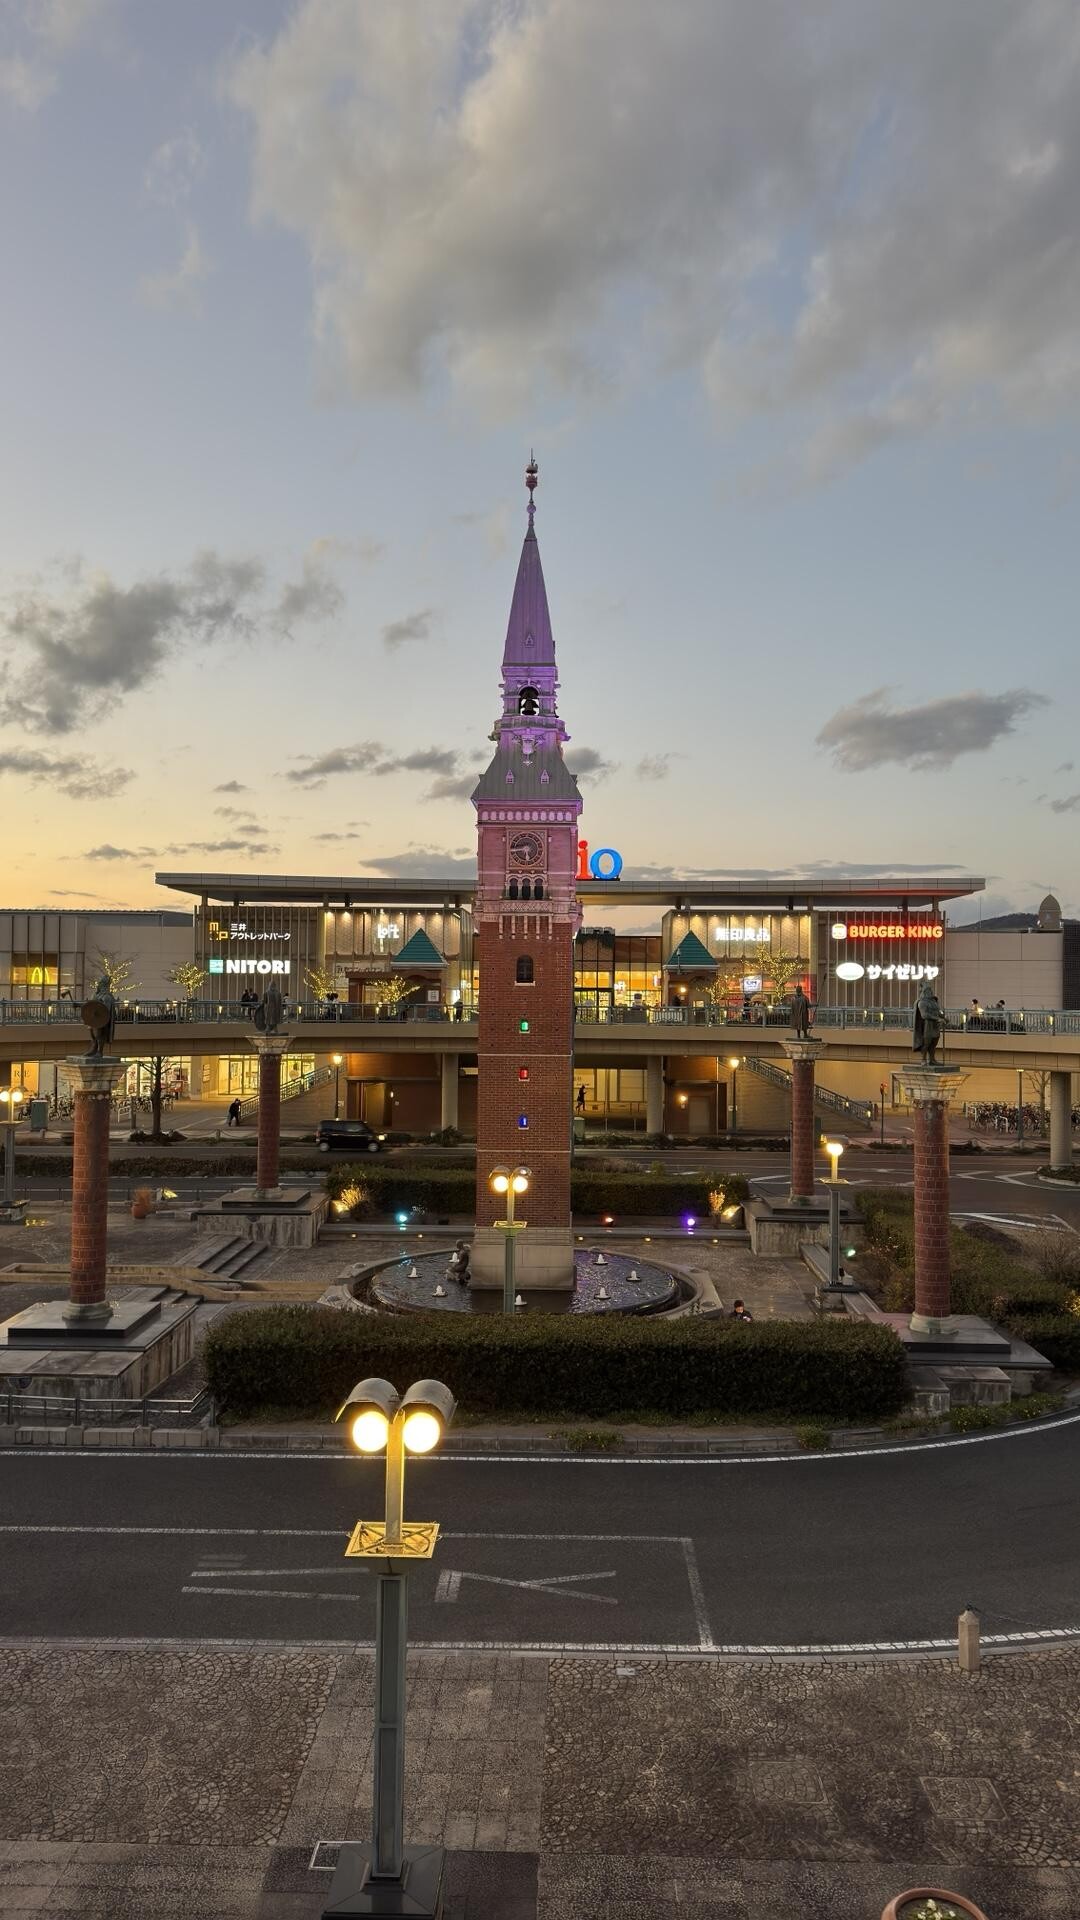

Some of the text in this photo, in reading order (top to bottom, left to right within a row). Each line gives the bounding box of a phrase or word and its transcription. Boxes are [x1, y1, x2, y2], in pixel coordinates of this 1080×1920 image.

[230, 923, 247, 931] 三井
[849, 925, 943, 938] BURGER KING
[230, 932, 291, 940] アウトレットパーク
[715, 927, 770, 941] 無印良品
[226, 959, 291, 974] NITORI
[866, 963, 940, 980] サイゼリヤ
